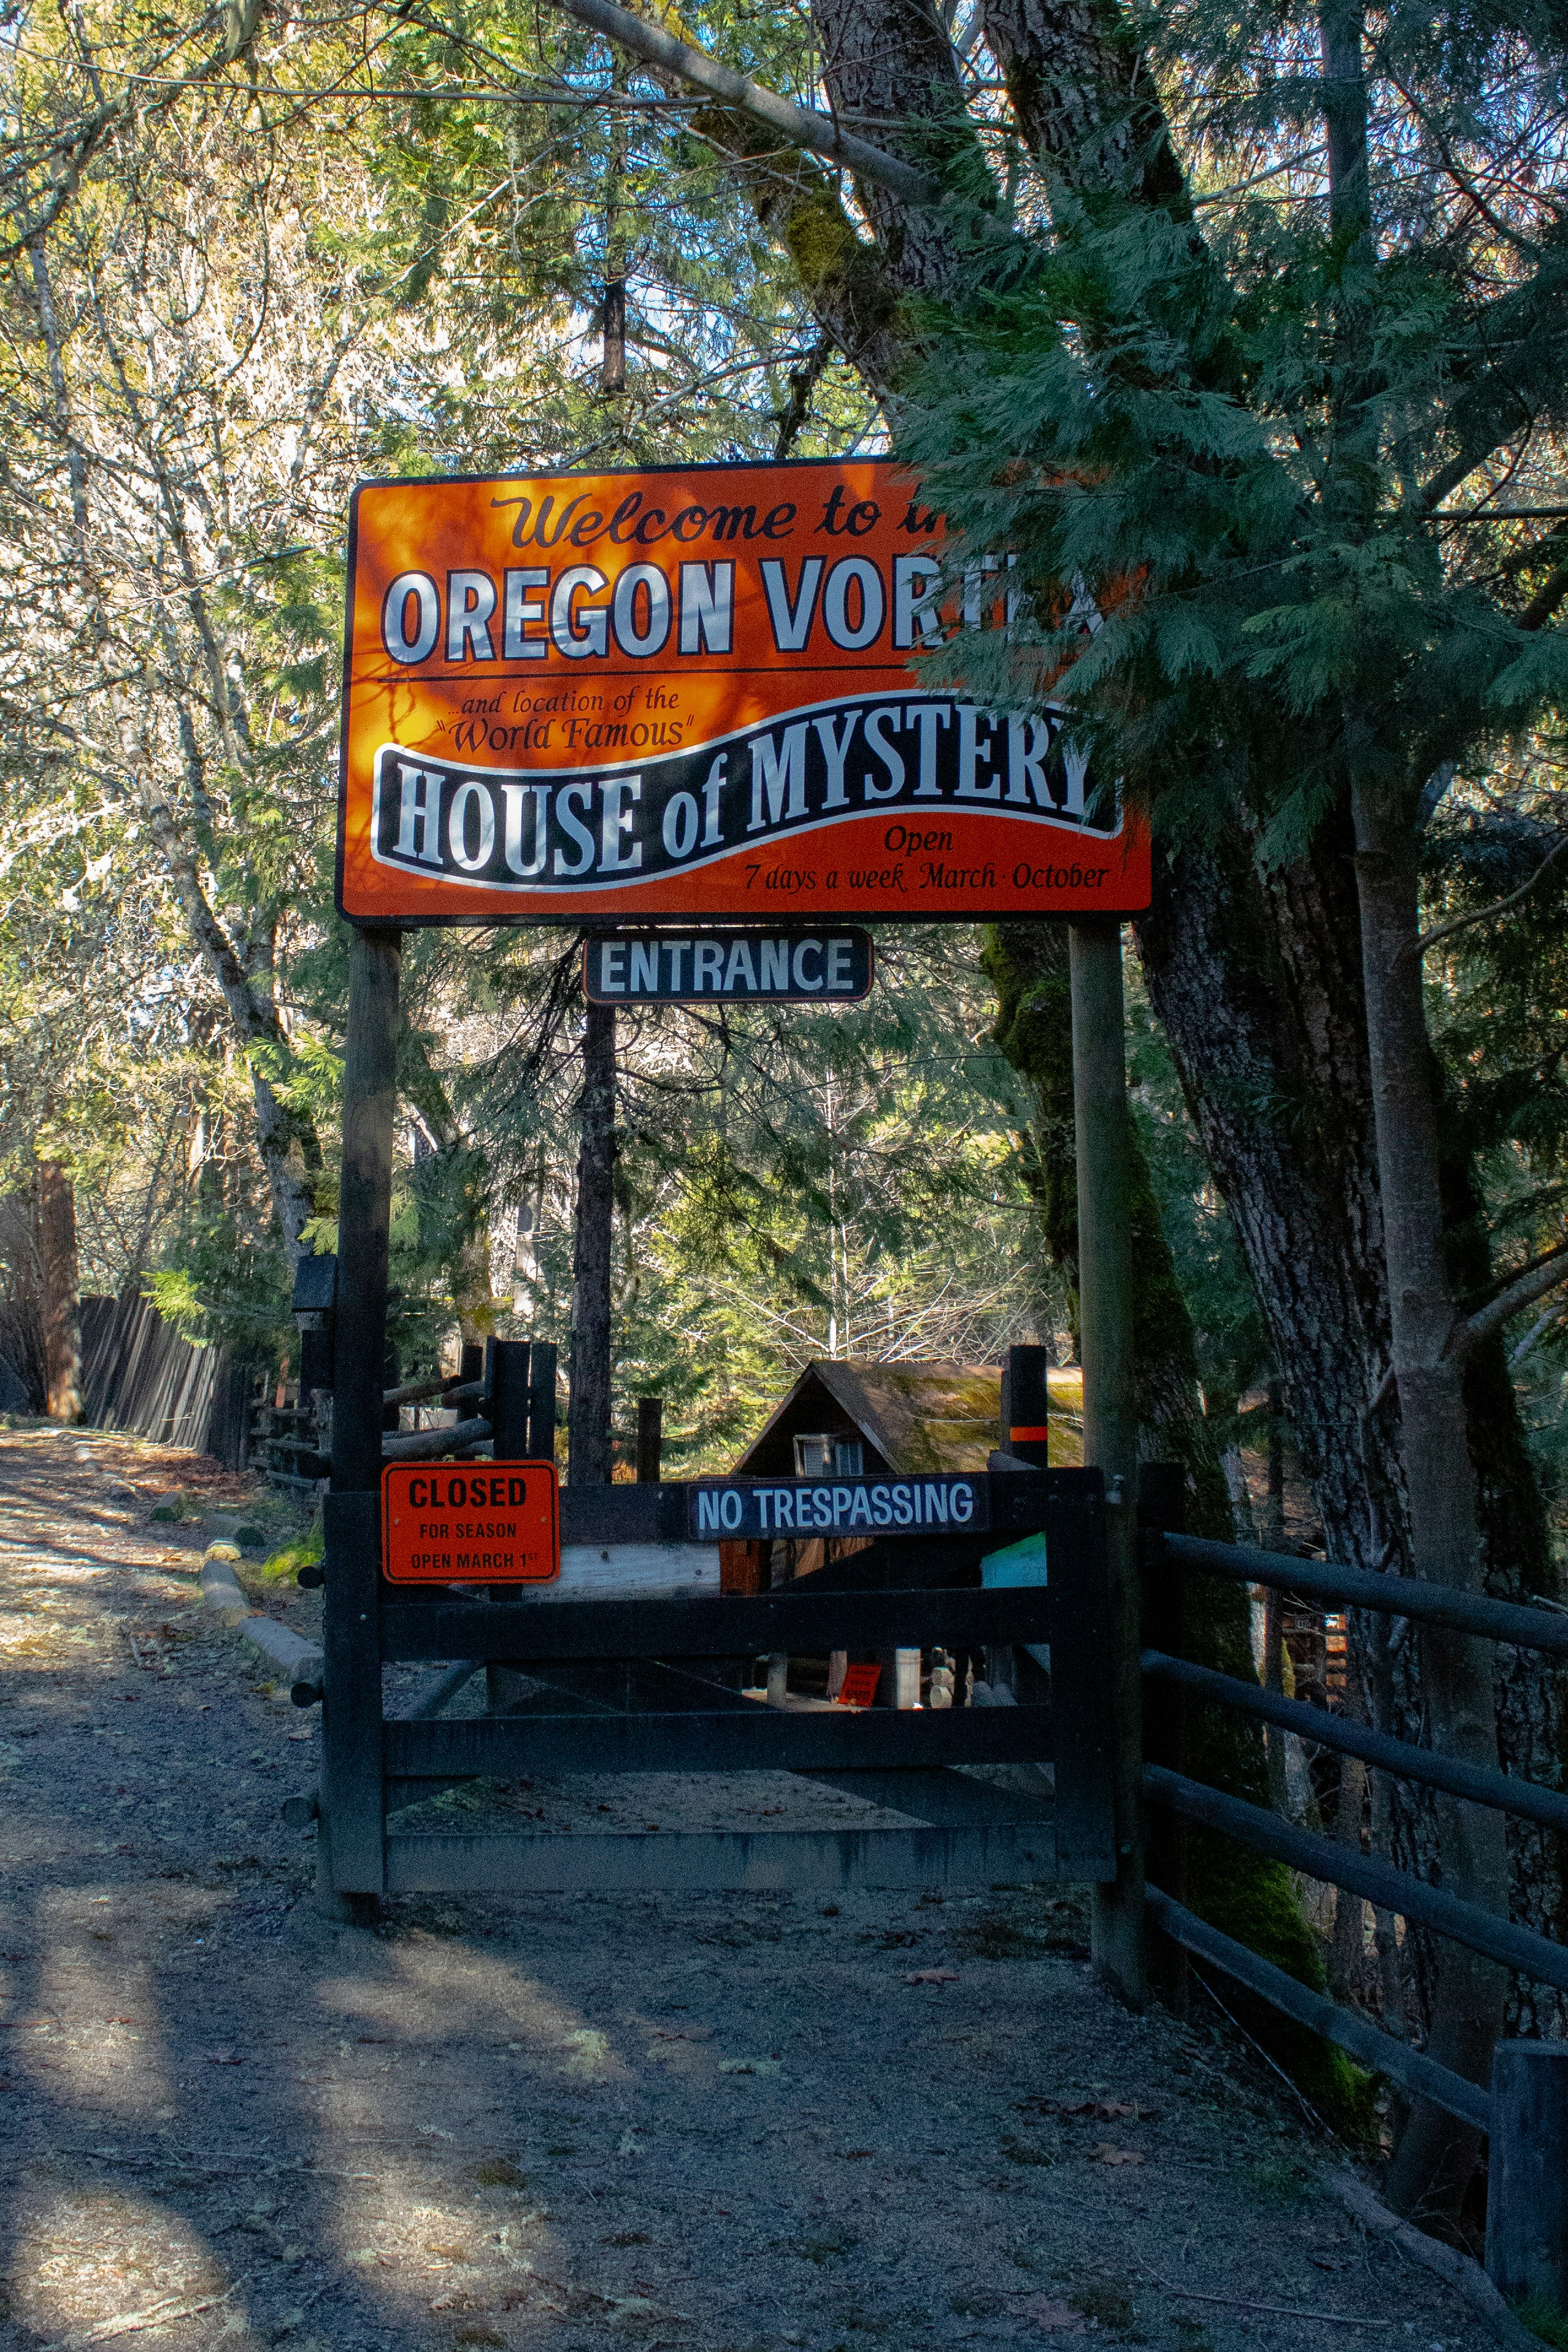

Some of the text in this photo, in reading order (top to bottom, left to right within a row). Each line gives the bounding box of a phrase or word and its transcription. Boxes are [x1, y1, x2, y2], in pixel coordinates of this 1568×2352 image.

[490, 491, 796, 548] Welcome
[814, 483, 882, 537] to
[381, 558, 736, 666] OREGON
[512, 689, 604, 713] location
[613, 685, 641, 718] of
[645, 685, 680, 710] the
[393, 703, 1095, 877] HOUSE of MYSTERY
[883, 825, 953, 857] Open
[745, 864, 761, 889] 7
[766, 864, 817, 895] days
[826, 870, 838, 889] a
[848, 863, 908, 893] week
[919, 862, 996, 889] March
[1012, 862, 1110, 889] October
[601, 939, 853, 992] ENTRANCE
[409, 1477, 527, 1508] CLOSED
[697, 1482, 974, 1529] NO TRESPASSING
[420, 1523, 517, 1539] FOR SEASON
[411, 1553, 451, 1569] OPEN
[456, 1553, 514, 1568] MARCH
